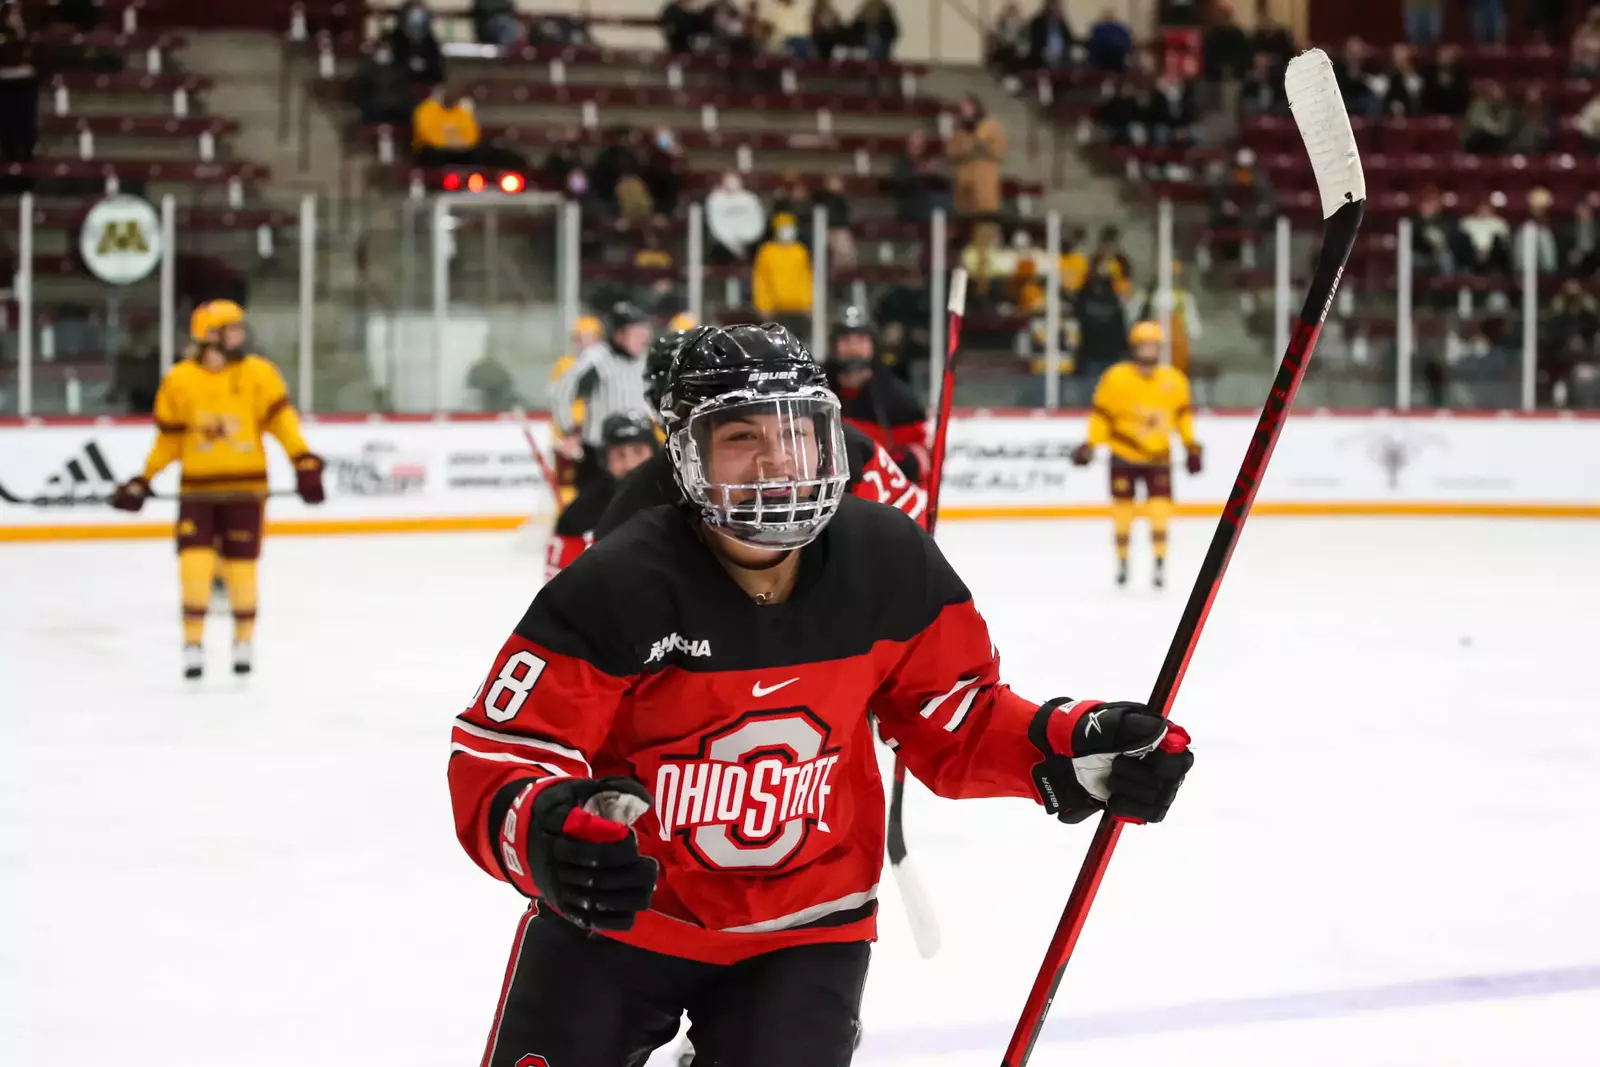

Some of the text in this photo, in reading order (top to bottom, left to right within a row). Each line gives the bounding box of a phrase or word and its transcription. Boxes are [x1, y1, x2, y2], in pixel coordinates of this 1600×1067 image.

[748, 371, 798, 382] BAUER
[863, 446, 906, 504] 23
[655, 753, 840, 842] OHIO STATE
[1041, 776, 1060, 808] BAUER
